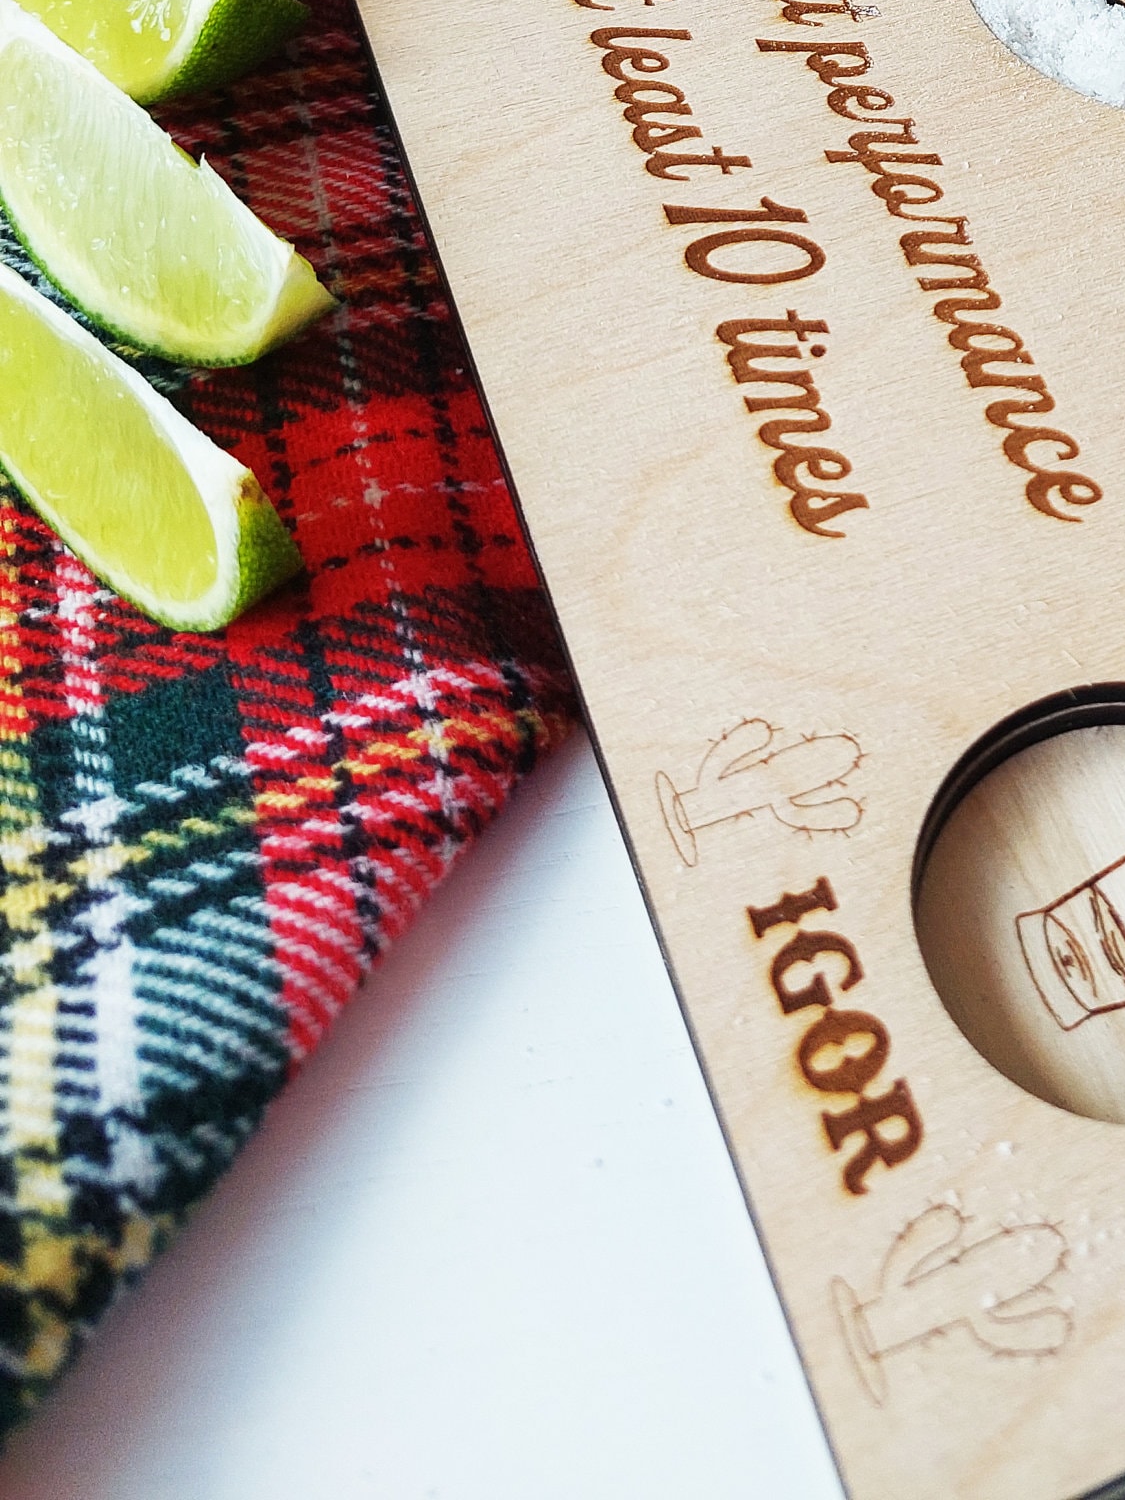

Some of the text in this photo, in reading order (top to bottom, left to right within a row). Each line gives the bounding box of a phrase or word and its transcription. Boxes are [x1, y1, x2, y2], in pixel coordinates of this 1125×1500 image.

[590, 25, 753, 182] least
[662, 195, 827, 286] 10
[754, 37, 1104, 525] performance
[714, 307, 870, 540] times
[744, 875, 925, 1196] IGOR
